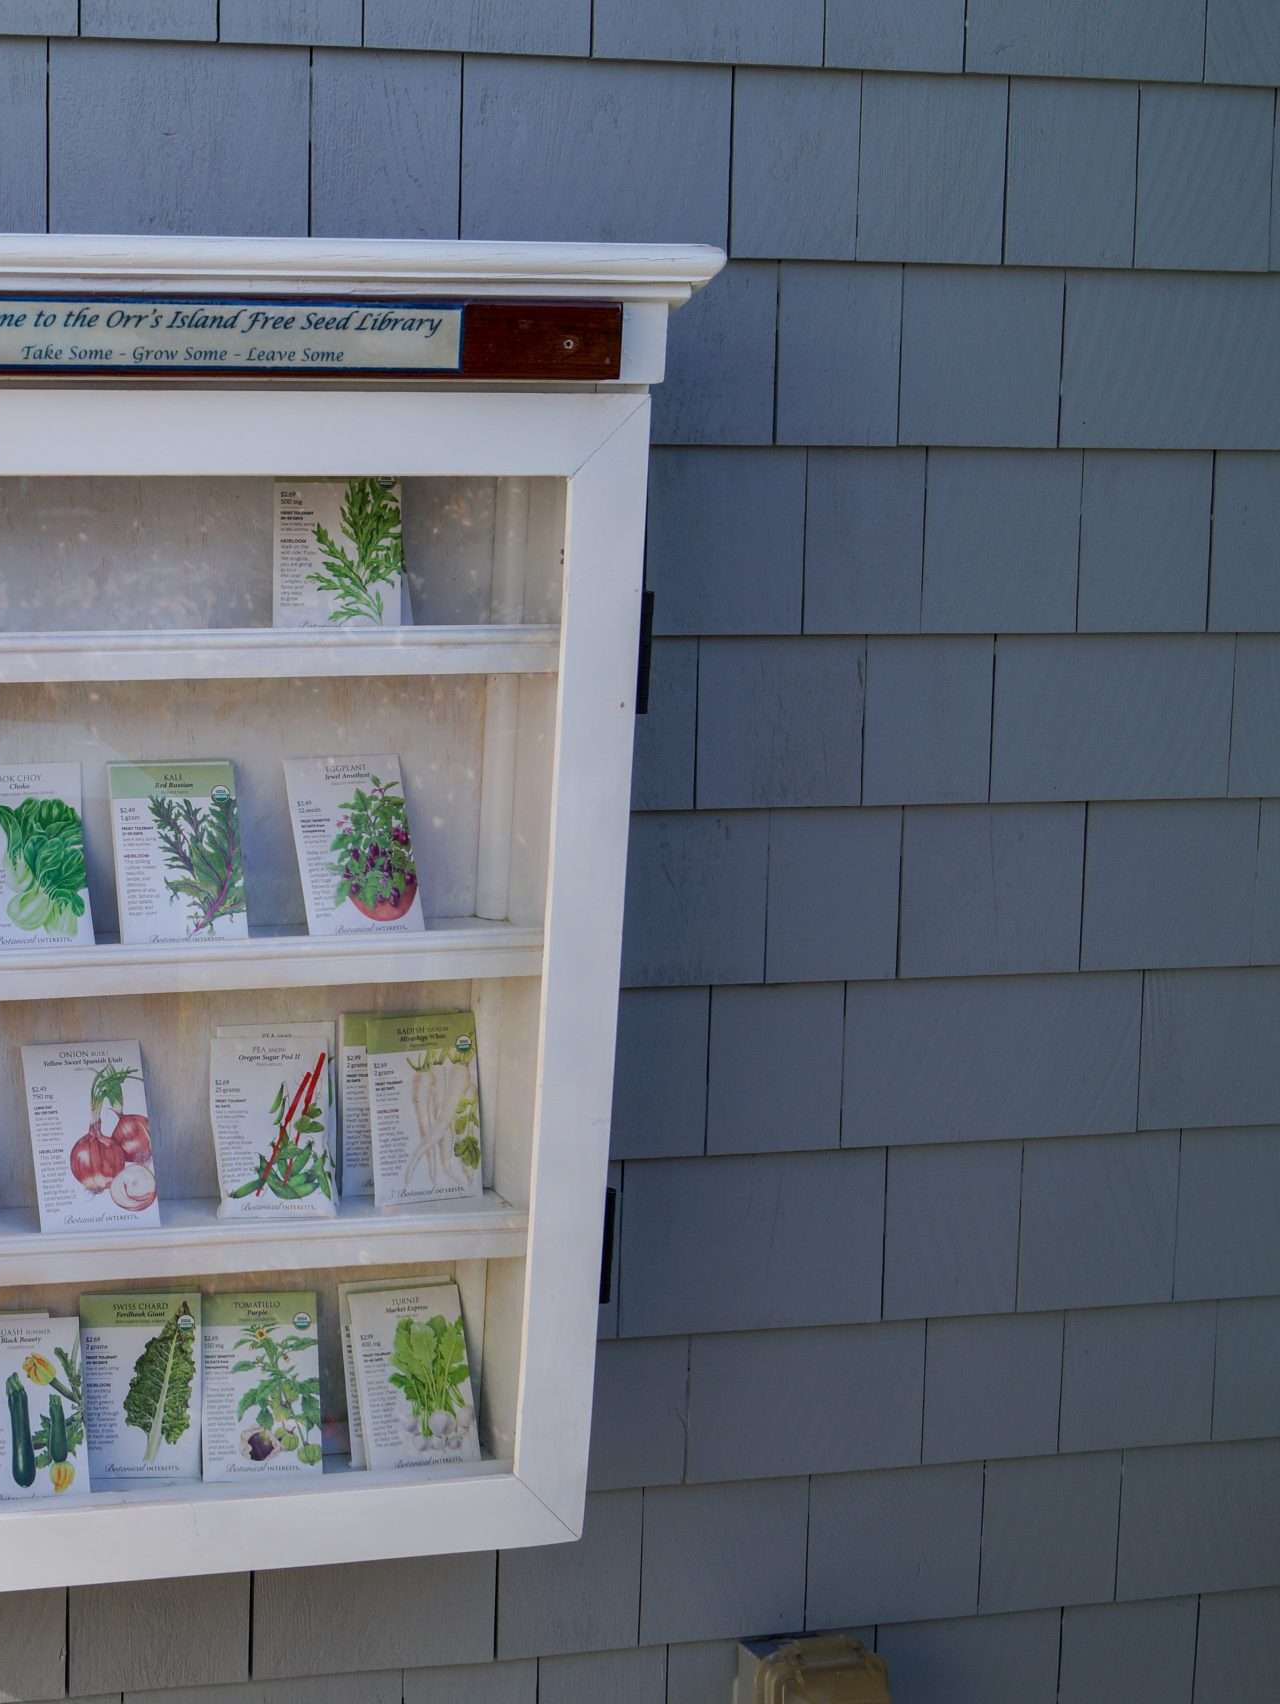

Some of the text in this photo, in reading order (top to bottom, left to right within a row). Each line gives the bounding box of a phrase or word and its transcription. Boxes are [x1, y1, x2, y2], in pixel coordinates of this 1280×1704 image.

[34, 311, 55, 327] to
[64, 307, 98, 327] the
[106, 309, 161, 329] Orr's
[166, 310, 246, 329] Island
[241, 310, 293, 333] Free
[300, 311, 359, 330] Seed
[355, 312, 442, 338] Library
[21, 344, 344, 363] Take Some Grow Some Leave Some
[326, 764, 367, 772] EGGPLANT
[336, 923, 375, 934] Botanical
[149, 934, 192, 943] Botanical
[397, 1027, 425, 1035] RADISH
[399, 1187, 434, 1197] Botanical
[241, 1202, 282, 1211] Botanical
[64, 1213, 105, 1224] Botanical
[234, 1301, 280, 1309] TOMATILLO
[391, 1297, 420, 1305] TURNIP
[385, 1306, 405, 1314] Market
[105, 1463, 146, 1472] Botanical
[226, 1463, 267, 1472] Botanical
[396, 1457, 432, 1469] Botanical
